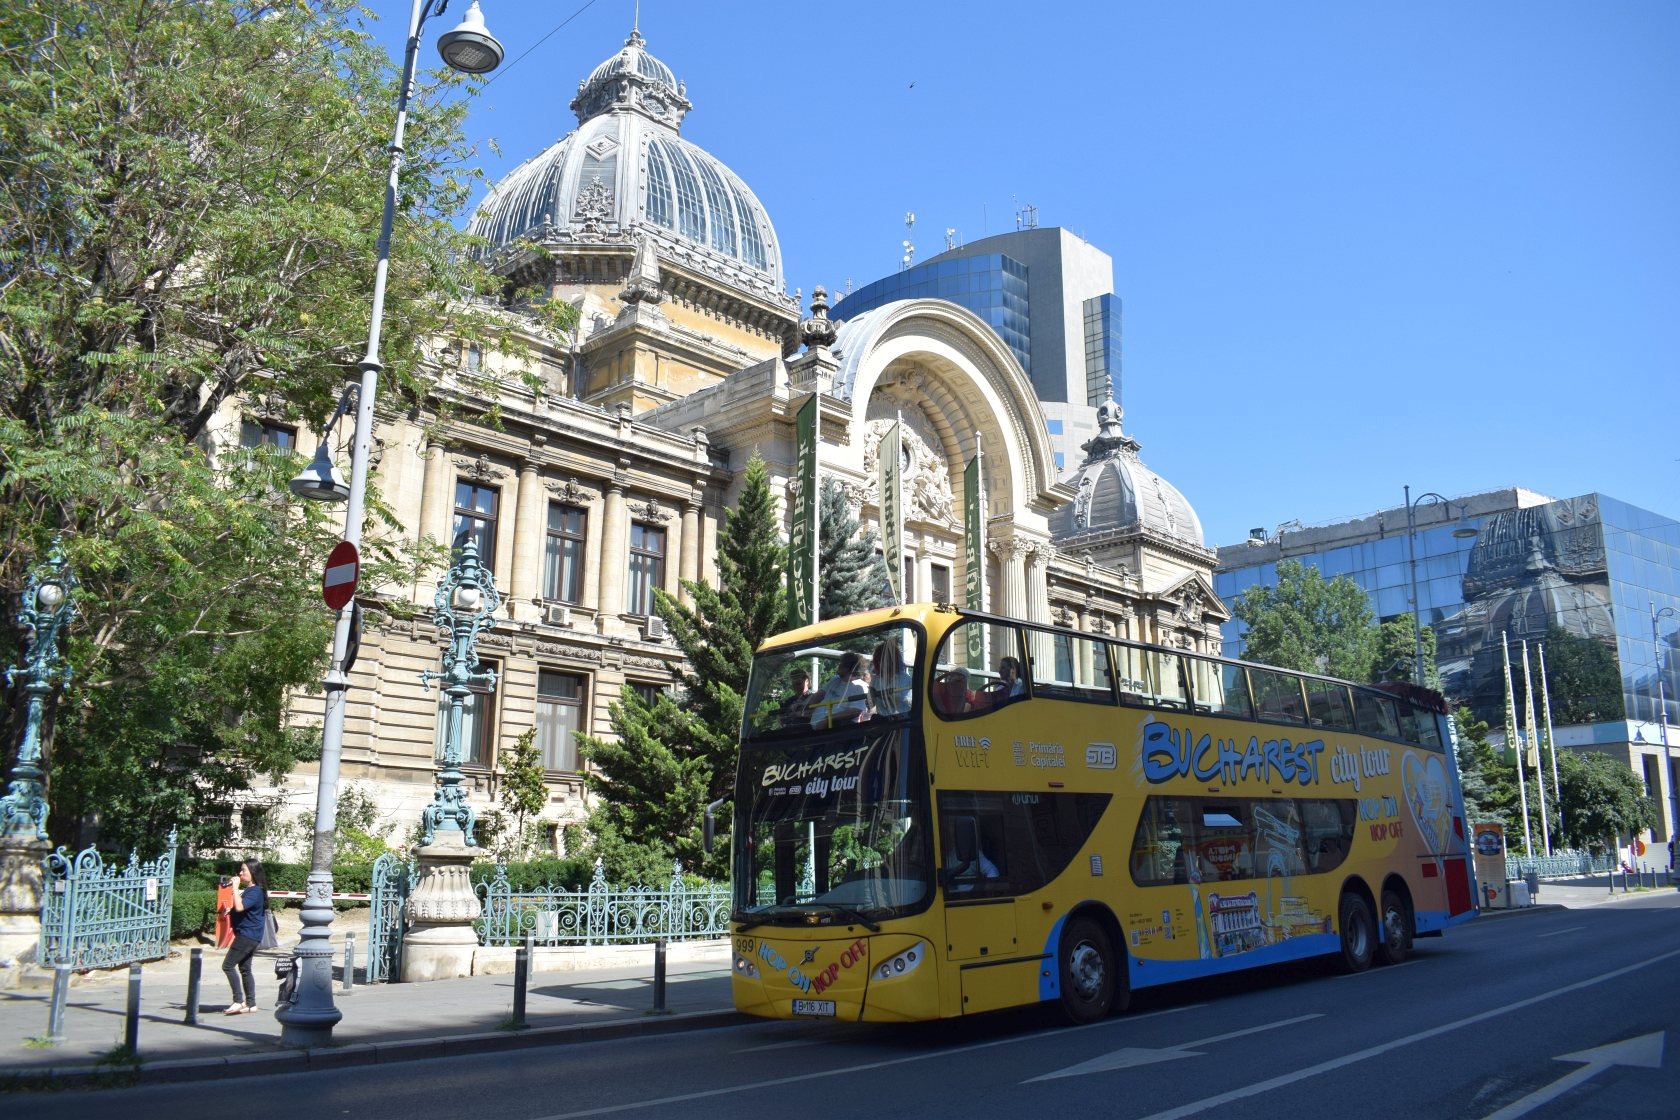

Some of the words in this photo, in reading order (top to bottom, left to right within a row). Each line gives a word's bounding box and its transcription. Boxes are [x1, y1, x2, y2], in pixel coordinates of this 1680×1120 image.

[793, 556, 807, 620] CEC
[761, 745, 869, 787] BUCHAREST
[1030, 754, 1066, 769] Capitalei
[1086, 749, 1115, 766] STB
[1142, 721, 1325, 787] BUCHAREST
[1330, 744, 1360, 791] city
[1360, 744, 1391, 779] tour
[805, 776, 829, 799] city
[830, 775, 859, 792] tour
[1359, 798, 1380, 821] HOP
[1381, 794, 1399, 818] ON
[1369, 823, 1387, 841] HOP
[1388, 821, 1404, 839] OFF
[735, 938, 754, 952] 999
[758, 941, 787, 971] HOP
[787, 966, 811, 995] ON
[811, 961, 839, 995] HOP
[840, 939, 866, 969] OFF
[818, 1002, 829, 1012] XIT
